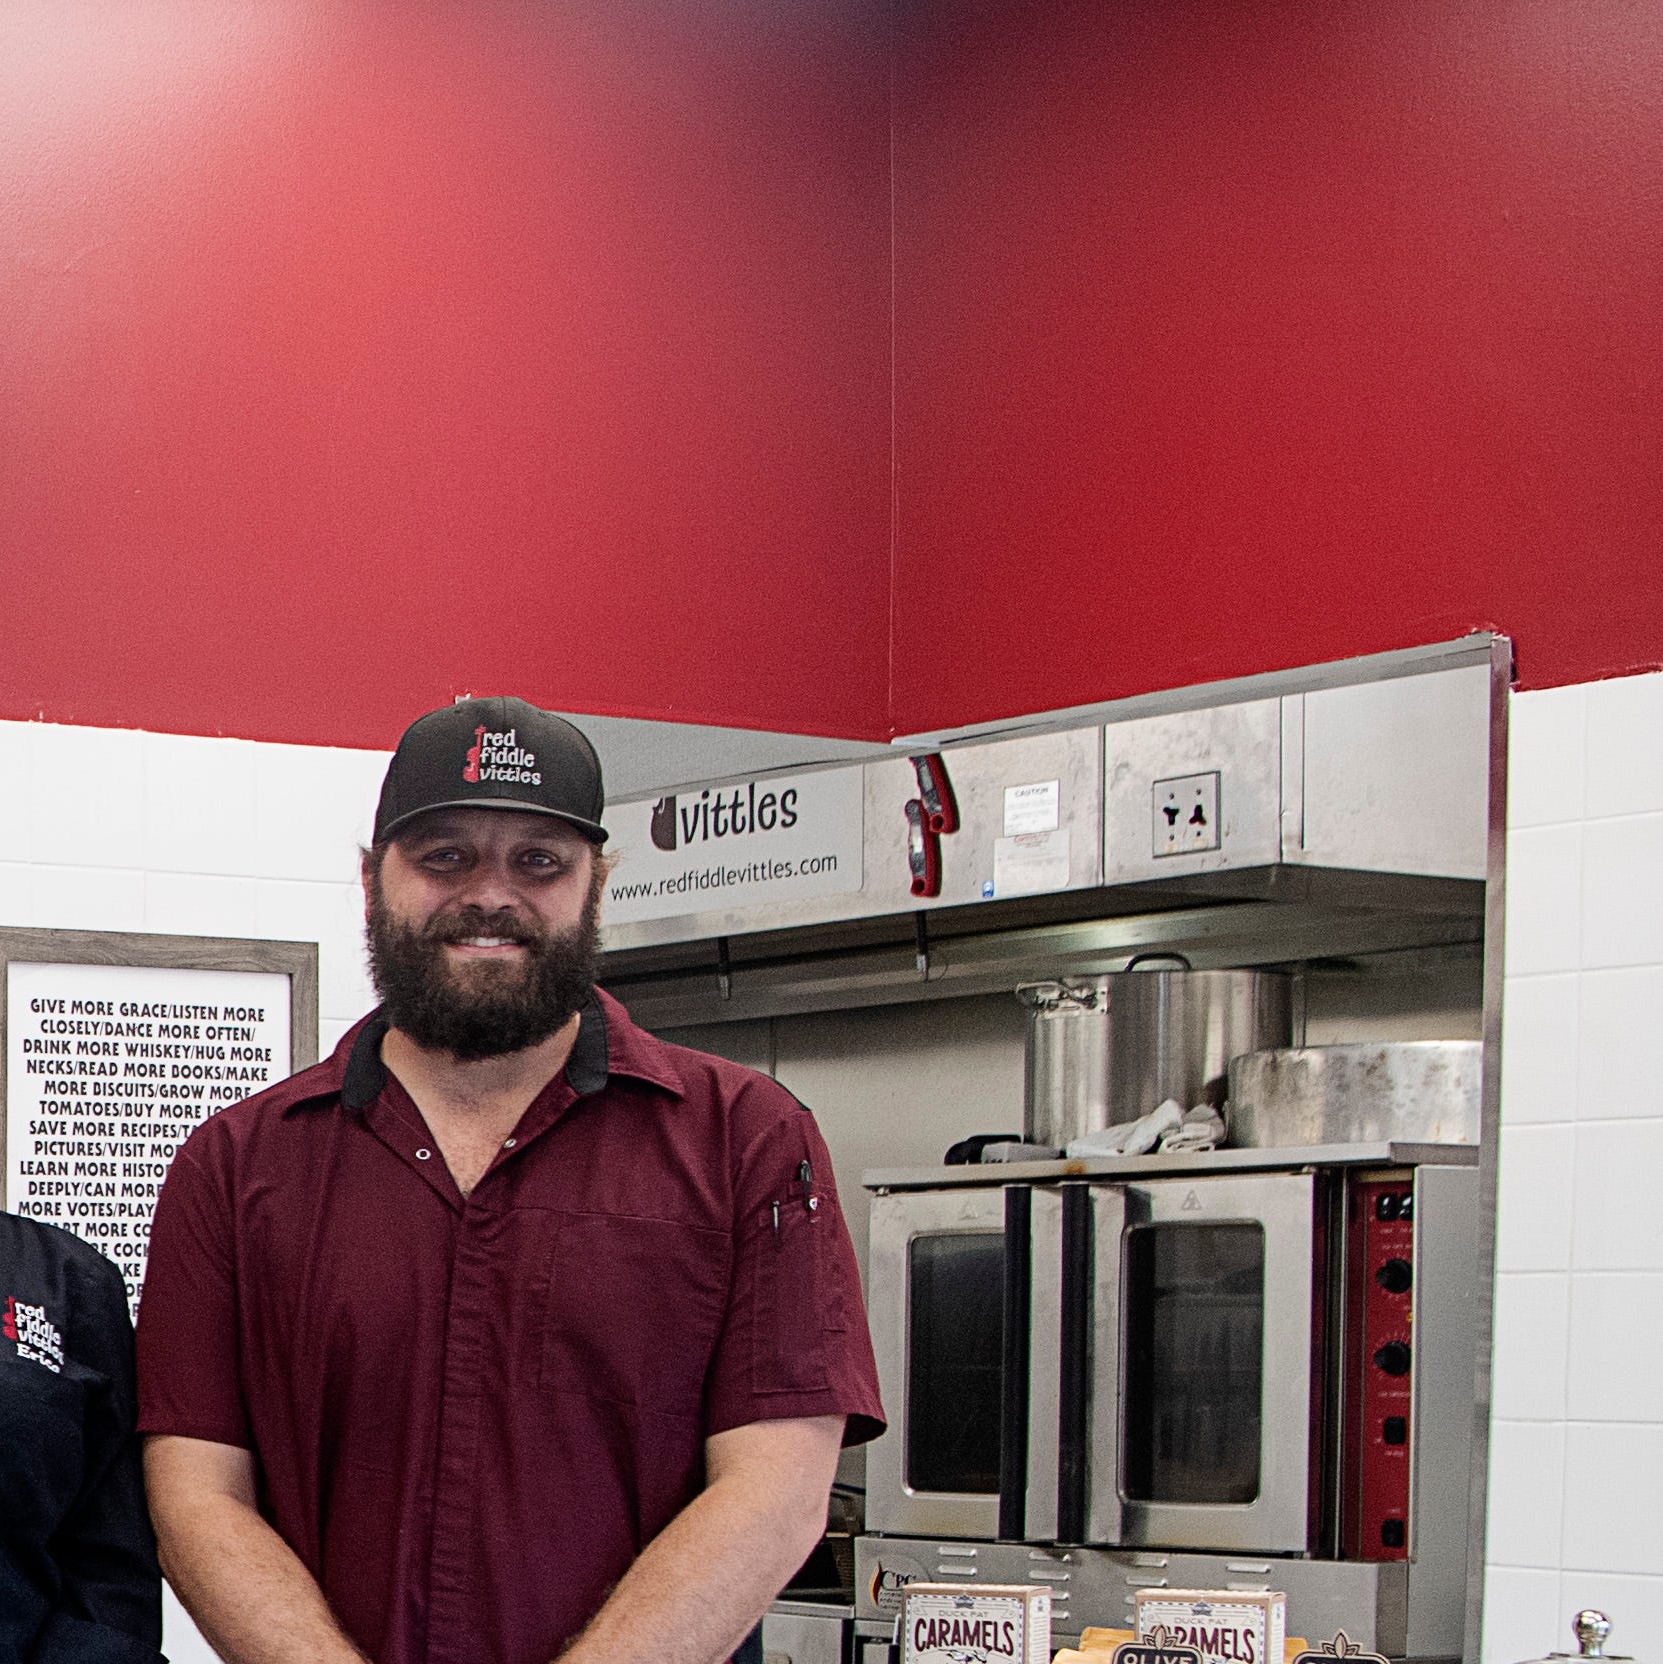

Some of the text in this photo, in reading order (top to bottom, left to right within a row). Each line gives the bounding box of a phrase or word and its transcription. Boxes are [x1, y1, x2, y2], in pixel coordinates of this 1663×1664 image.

[483, 728, 515, 747] red
[480, 746, 535, 768] fiddle
[479, 765, 542, 786] vittles
[681, 782, 798, 845] vittles
[611, 852, 838, 902] www.redfiddlevittles.com
[31, 998, 265, 1022] GIVE MORE GRACE/LISTEN MORE
[40, 1019, 256, 1042] CLOSELY/DANCE MORE OFTEN/
[23, 1038, 272, 1062] DRINK MORE WHISKEY/HUG MORE
[26, 1060, 269, 1082] NECKS/READ MORE BOOKS/MAKE
[44, 1080, 87, 1096] MORE
[93, 1082, 205, 1100] BISCUITS/GROW
[39, 1100, 154, 1118] TOMATOES/BUY
[159, 1104, 201, 1119] MORE
[29, 1120, 67, 1136] SAVE
[73, 1122, 115, 1137] MORE
[34, 1140, 146, 1157] PICTURES/VISIT
[20, 1160, 69, 1176] LEARN
[75, 1162, 117, 1177] MORE
[28, 1181, 116, 1197] DEEPLY/CAN
[18, 1201, 155, 1218] MORE VOTES/PLAY
[85, 1223, 128, 1238] MORE
[15, 1302, 45, 1322] red
[14, 1313, 61, 1346] fiddle
[913, 1616, 1015, 1657] CARAMELS
